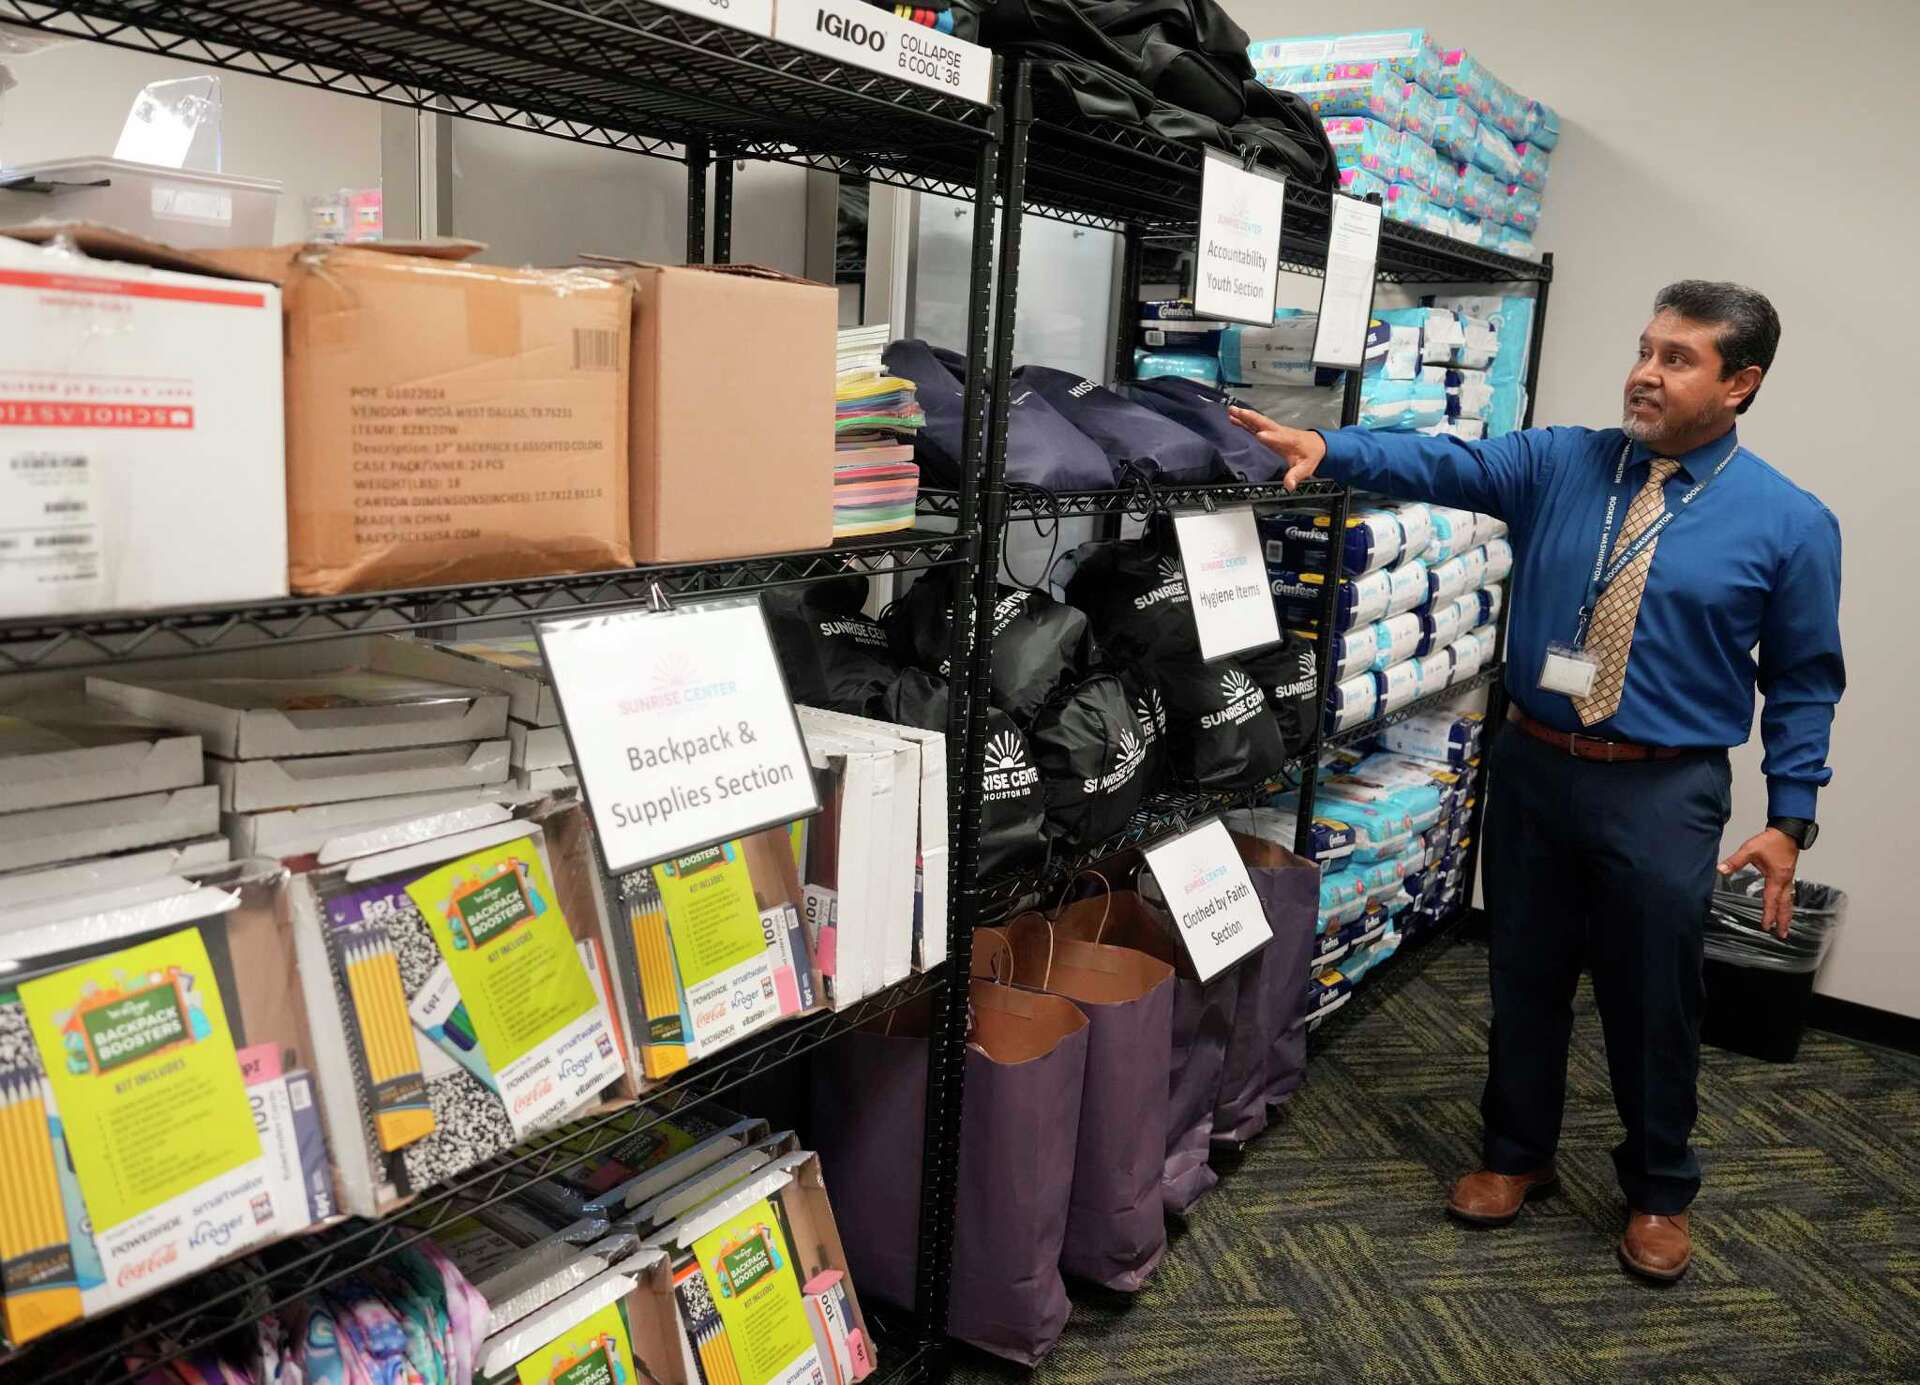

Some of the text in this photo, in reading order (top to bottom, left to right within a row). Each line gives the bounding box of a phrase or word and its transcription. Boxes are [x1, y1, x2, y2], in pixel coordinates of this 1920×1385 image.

[816, 9, 885, 52] IGLOO
[900, 33, 962, 69] COLLAPSE
[898, 52, 960, 87] & COOL 36
[1207, 240, 1268, 272] Accountability
[1206, 271, 1264, 299] Youth Section
[1605, 496, 1617, 524] BOOKER
[1593, 532, 1608, 582] WASHINGTON
[1604, 553, 1629, 583] BOOKER
[1633, 511, 1674, 552] WASHINGTON
[1134, 582, 1185, 610] SUNRISE
[1200, 584, 1261, 609] Hygiene Items
[820, 620, 868, 637] SUNRISE
[619, 691, 682, 716] SUNRISE
[684, 681, 737, 703] CENTER
[1275, 679, 1314, 698] SUNRISE
[1200, 700, 1247, 729] SUNRISE
[626, 720, 758, 772] Backpack &
[983, 767, 1039, 791] RISE CENTE
[611, 763, 794, 828] Supplies Section
[983, 789, 1021, 801] HOUSTON
[679, 846, 721, 868] BOOSTERS
[467, 890, 522, 925] BACKPACK
[471, 901, 526, 937] BOOSTERS
[806, 896, 818, 924] 100
[1183, 883, 1250, 929] Clothed by Faith
[762, 917, 777, 947] 100
[1211, 919, 1243, 945] Section
[731, 990, 760, 1010] Kroger
[93, 1005, 177, 1047] BACKPACK
[99, 1019, 182, 1061] BOOSTERS
[558, 1052, 594, 1080] Kroger
[188, 1214, 245, 1249] Kroger
[730, 1249, 766, 1279] BACKPACK
[733, 1257, 769, 1287] BOOSTERS
[821, 1294, 835, 1322] 100
